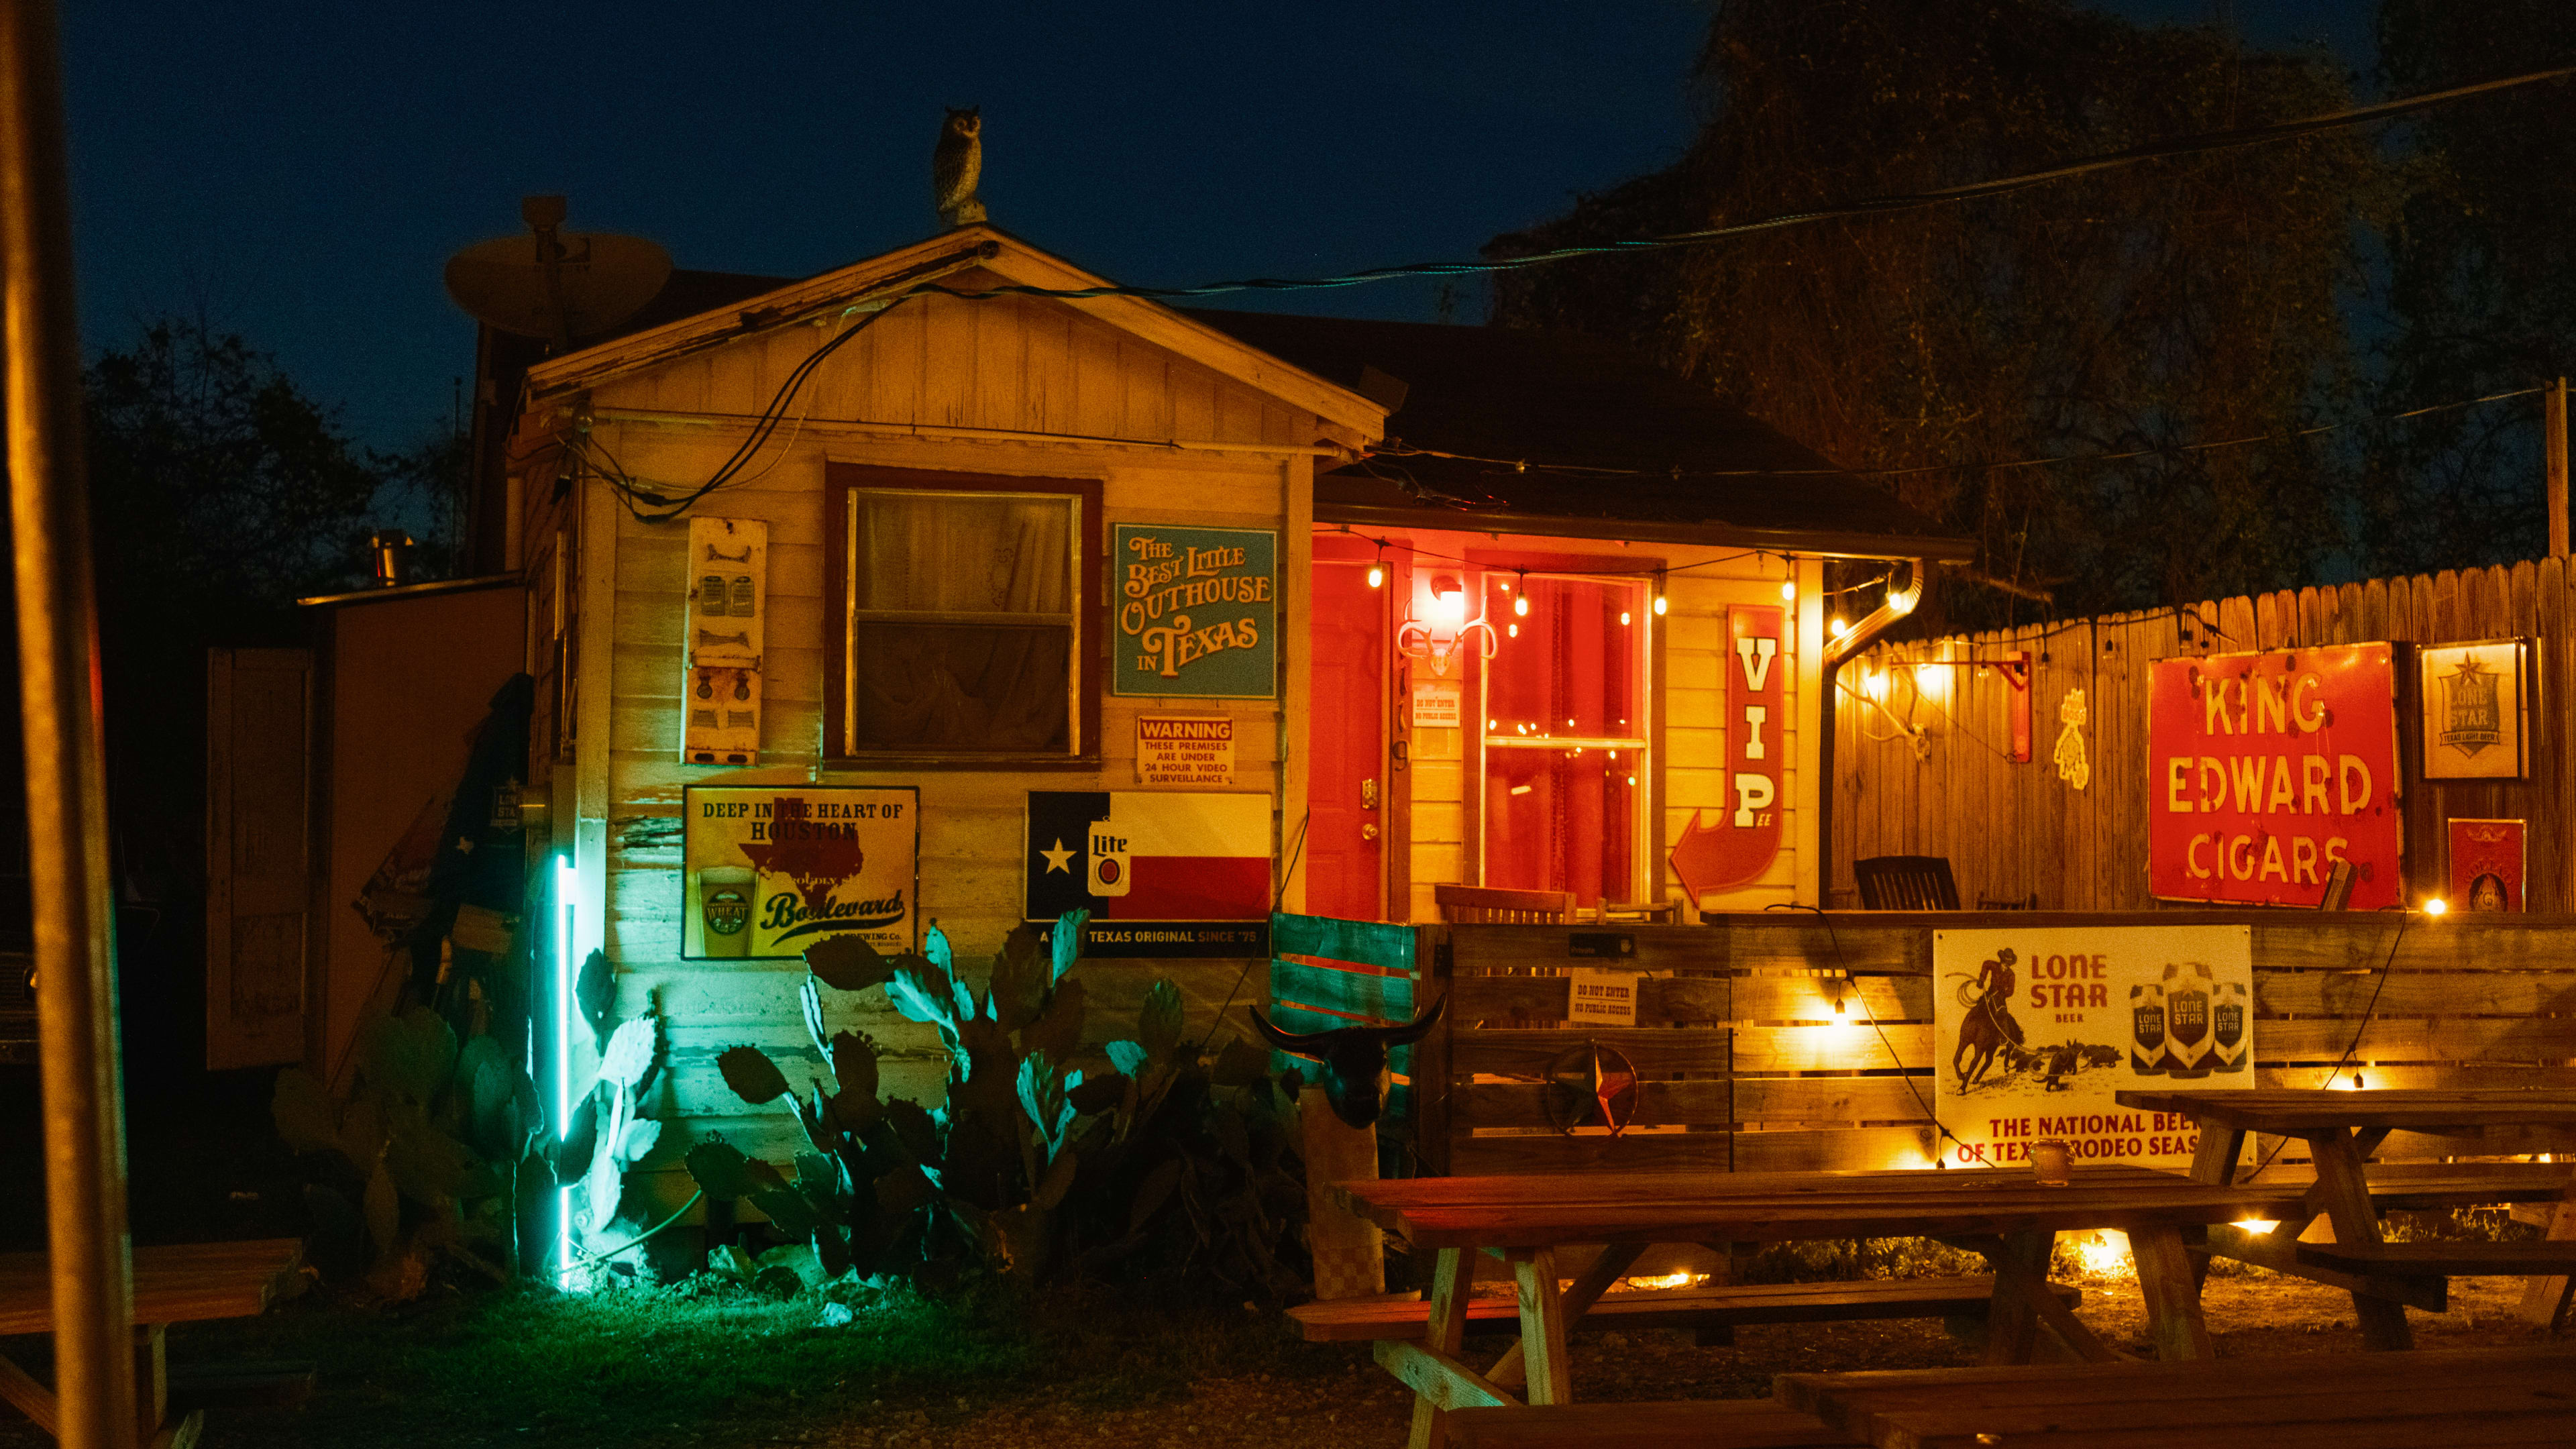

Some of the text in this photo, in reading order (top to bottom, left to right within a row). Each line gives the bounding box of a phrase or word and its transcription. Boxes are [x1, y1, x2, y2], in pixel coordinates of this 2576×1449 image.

[1129, 537, 1174, 560] THE
[1124, 546, 1246, 598] BEST LITTLE
[1121, 577, 1271, 635] OUTHOUSE
[1137, 615, 1258, 678] IN TEXAS
[1437, 699, 1455, 708] ENTER
[2205, 672, 2325, 735] KING
[2451, 709, 2488, 727] STAR
[1142, 722, 1230, 739] WARNING
[1145, 741, 1227, 751] THESE PREMISES
[1157, 753, 1215, 761] ARE UNDER
[1144, 763, 1228, 772] 24 HOUR VIDEO
[1150, 774, 1223, 783] SURVEILLANCE
[2169, 754, 2373, 815] EDWARD
[703, 803, 904, 818] DEEP IN THE HEART OF
[751, 822, 857, 841] HOUSTON
[1092, 835, 1128, 857] Lite
[2188, 833, 2349, 885] CIGARS
[707, 906, 748, 921] WHEAT
[760, 890, 905, 932] Boulevard
[1089, 931, 1132, 943] TEXAS
[1135, 931, 1195, 943] ORIGINAL
[1198, 931, 1235, 943] SINCE
[2031, 954, 2107, 979] LONE
[1578, 984, 1629, 998] DO NOT ENTER
[2031, 983, 2108, 1008] STAR
[1575, 1003, 1631, 1015] NO PUBLIC ACCESS
[2175, 1000, 2202, 1013] LONE
[2055, 1014, 2084, 1023] BEER
[2139, 1014, 2161, 1024] LONE
[2175, 1013, 2203, 1025] STAR
[2217, 1012, 2239, 1022] LONE
[2139, 1024, 2162, 1034] STAR
[2217, 1022, 2239, 1032] STAR
[1989, 1118, 2031, 1138] THE
[2039, 1114, 2146, 1136] NATIONAL
[1957, 1143, 1985, 1163] OF
[1992, 1141, 2031, 1162] TEX
[2149, 1135, 2198, 1156] SEAS
